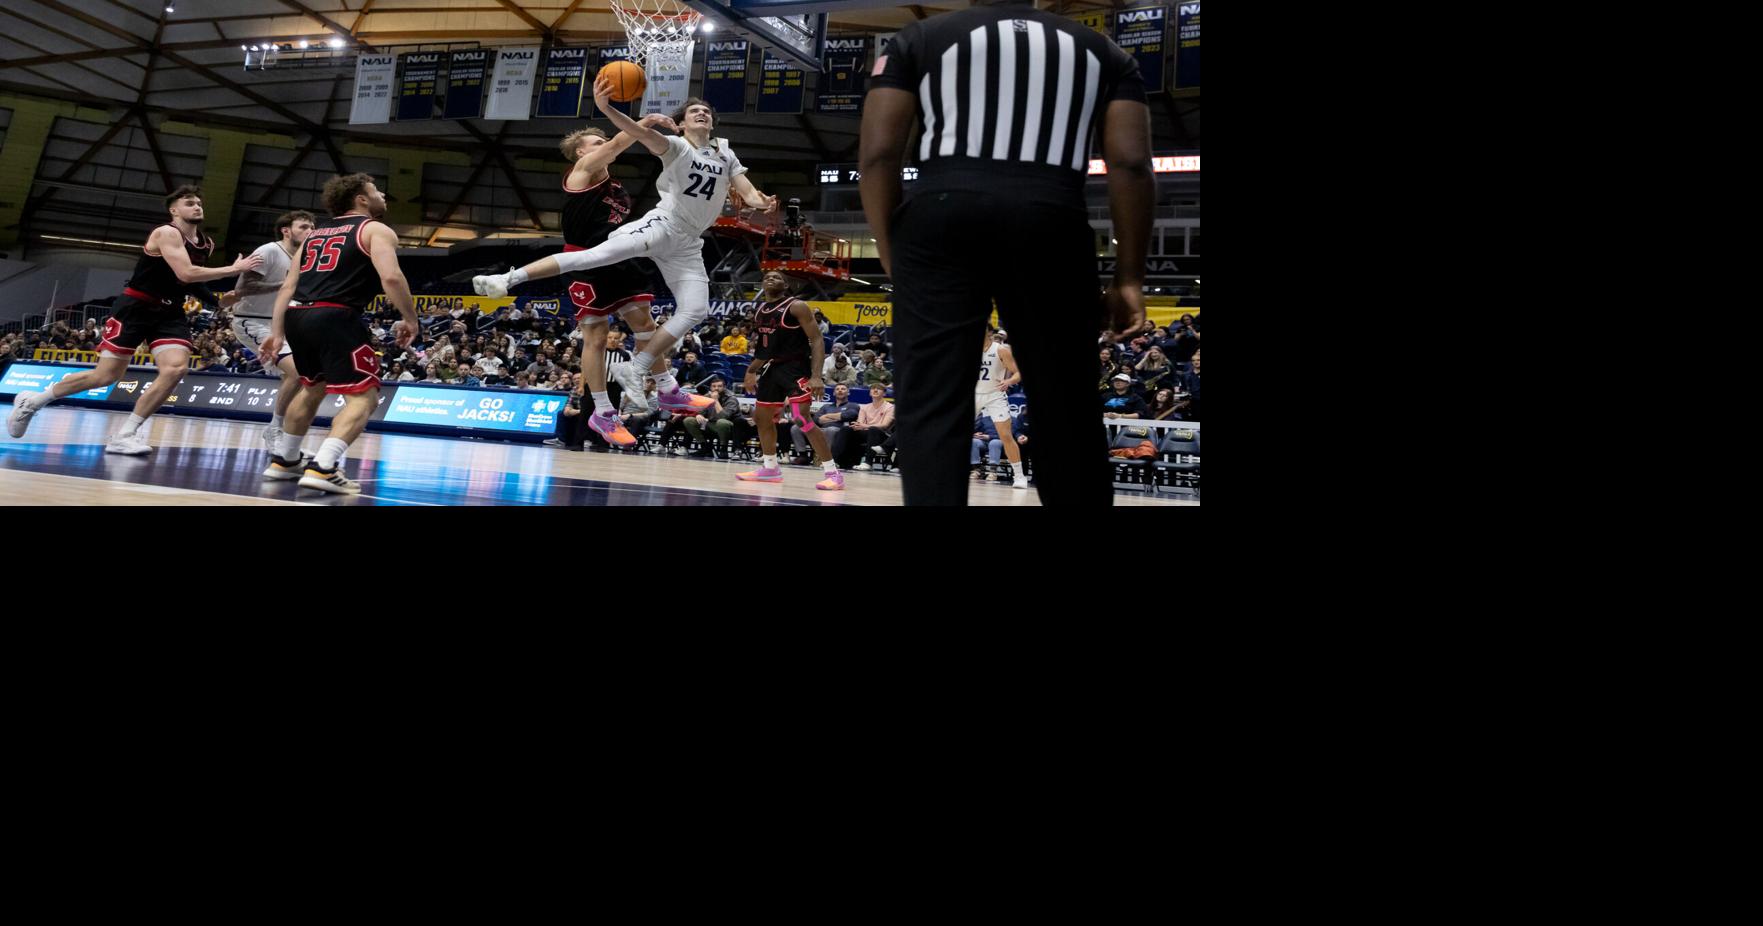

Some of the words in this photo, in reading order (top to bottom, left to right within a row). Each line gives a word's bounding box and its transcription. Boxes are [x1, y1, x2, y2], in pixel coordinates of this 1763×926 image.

[1118, 9, 1163, 23] NAU
[709, 41, 747, 51] NAU
[824, 39, 864, 49] NAU
[1117, 36, 1161, 46] CHAMPIONS
[407, 54, 438, 63] NAU
[453, 52, 486, 61] NAU
[501, 51, 534, 60] NAU
[550, 49, 584, 58] NAU
[361, 57, 392, 66] NAU
[691, 160, 723, 175] NAU
[683, 173, 717, 201] 24
[300, 236, 347, 273] 55
[533, 302, 557, 310] NAU
[854, 303, 888, 323] 7000
[216, 382, 241, 393] 7:41
[188, 394, 197, 403] 8
[209, 396, 234, 405] 2ND
[247, 396, 260, 406] 10
[265, 397, 274, 407] 3
[454, 399, 465, 407] of
[479, 397, 504, 409] GO
[457, 408, 515, 423] JACKS!
